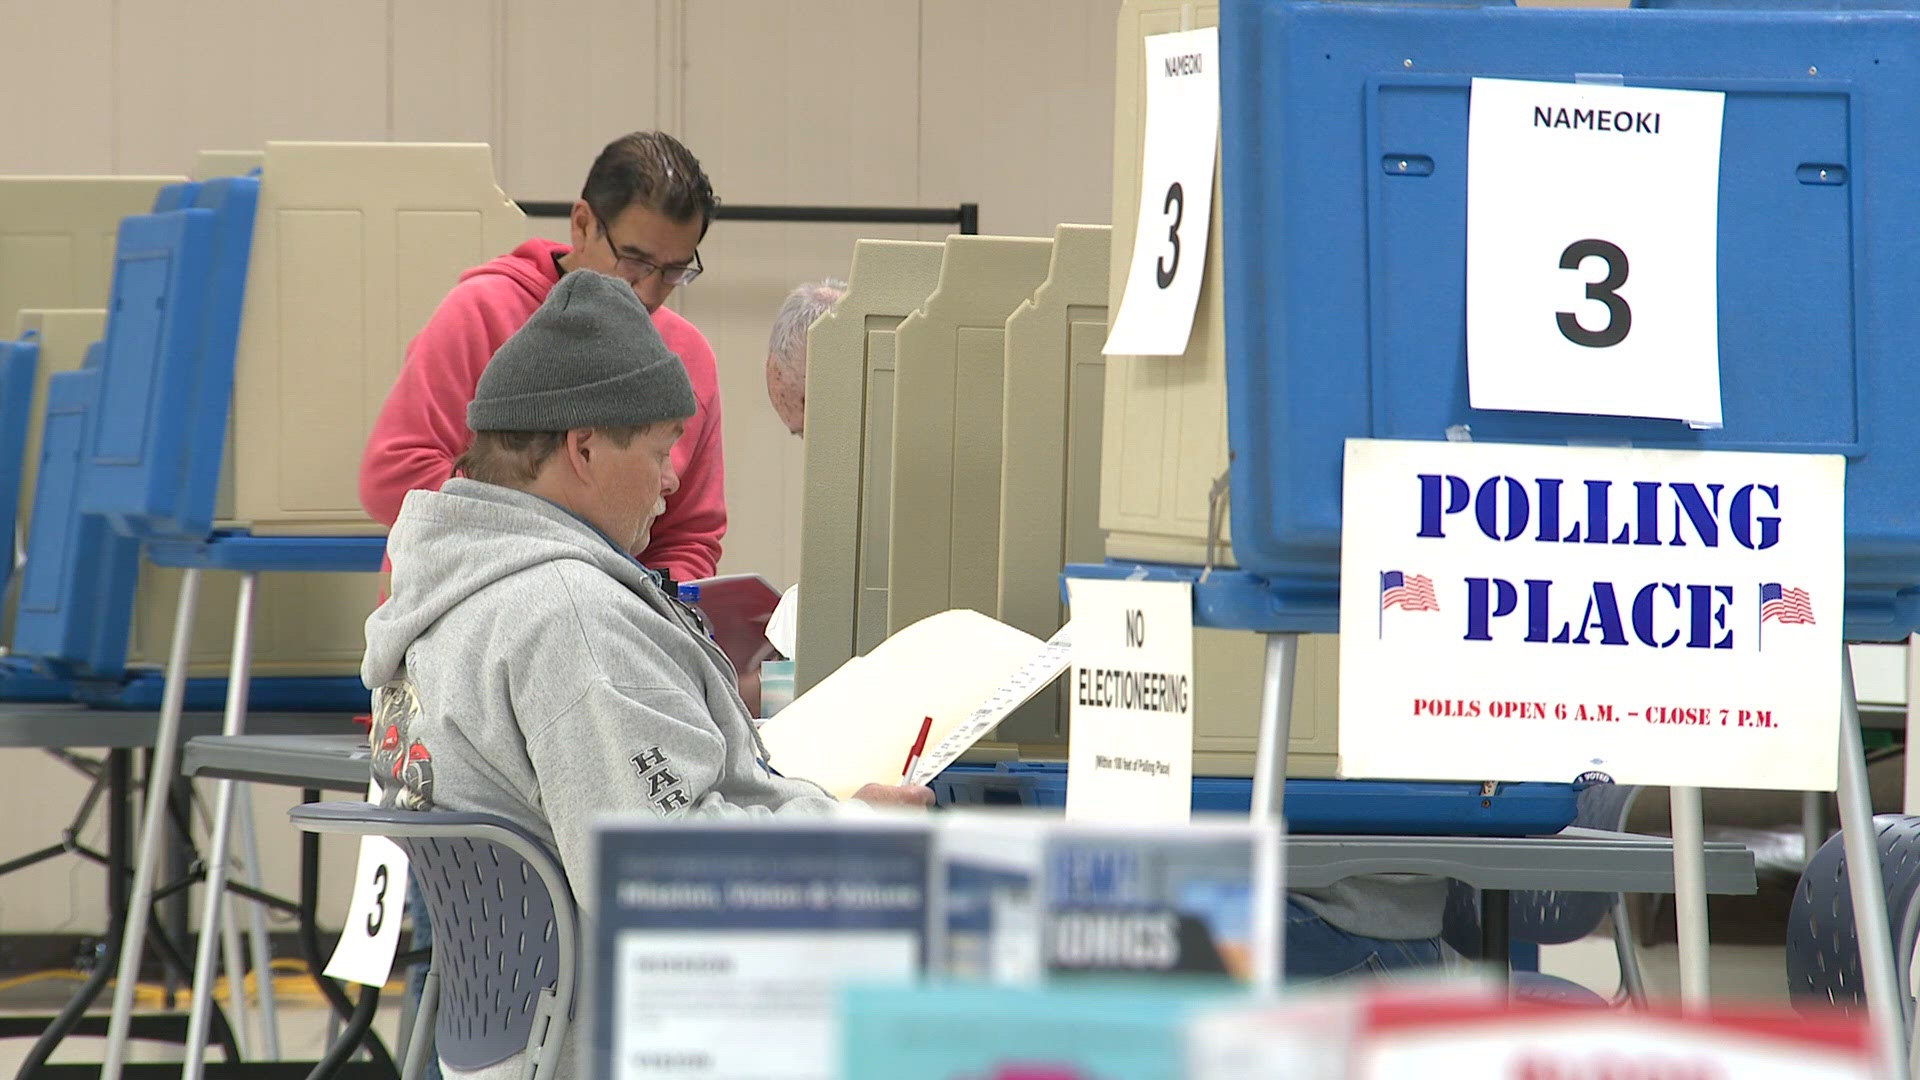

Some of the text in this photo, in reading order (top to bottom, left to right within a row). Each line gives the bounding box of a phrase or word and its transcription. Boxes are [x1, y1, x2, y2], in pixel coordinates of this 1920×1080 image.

[1164, 52, 1203, 77] NAMEOKI
[1533, 105, 1661, 134] NAMEOKI
[1156, 181, 1184, 290] 3
[1555, 238, 1632, 348] 3
[1415, 473, 1782, 551] POLLING
[1125, 608, 1145, 648] NO
[1462, 576, 1734, 650] PLACE
[1079, 667, 1188, 714] ELECTIONEERING
[1413, 698, 1481, 718] POLLS
[1488, 700, 1547, 720] OPEN
[1554, 702, 1568, 721] 6
[1574, 703, 1620, 723] A.M.
[1645, 706, 1711, 726] CLOSE
[1719, 708, 1731, 727] 7
[1737, 709, 1779, 729] P.M.
[1584, 772, 1610, 783] VOTED
[366, 863, 388, 938] 3
